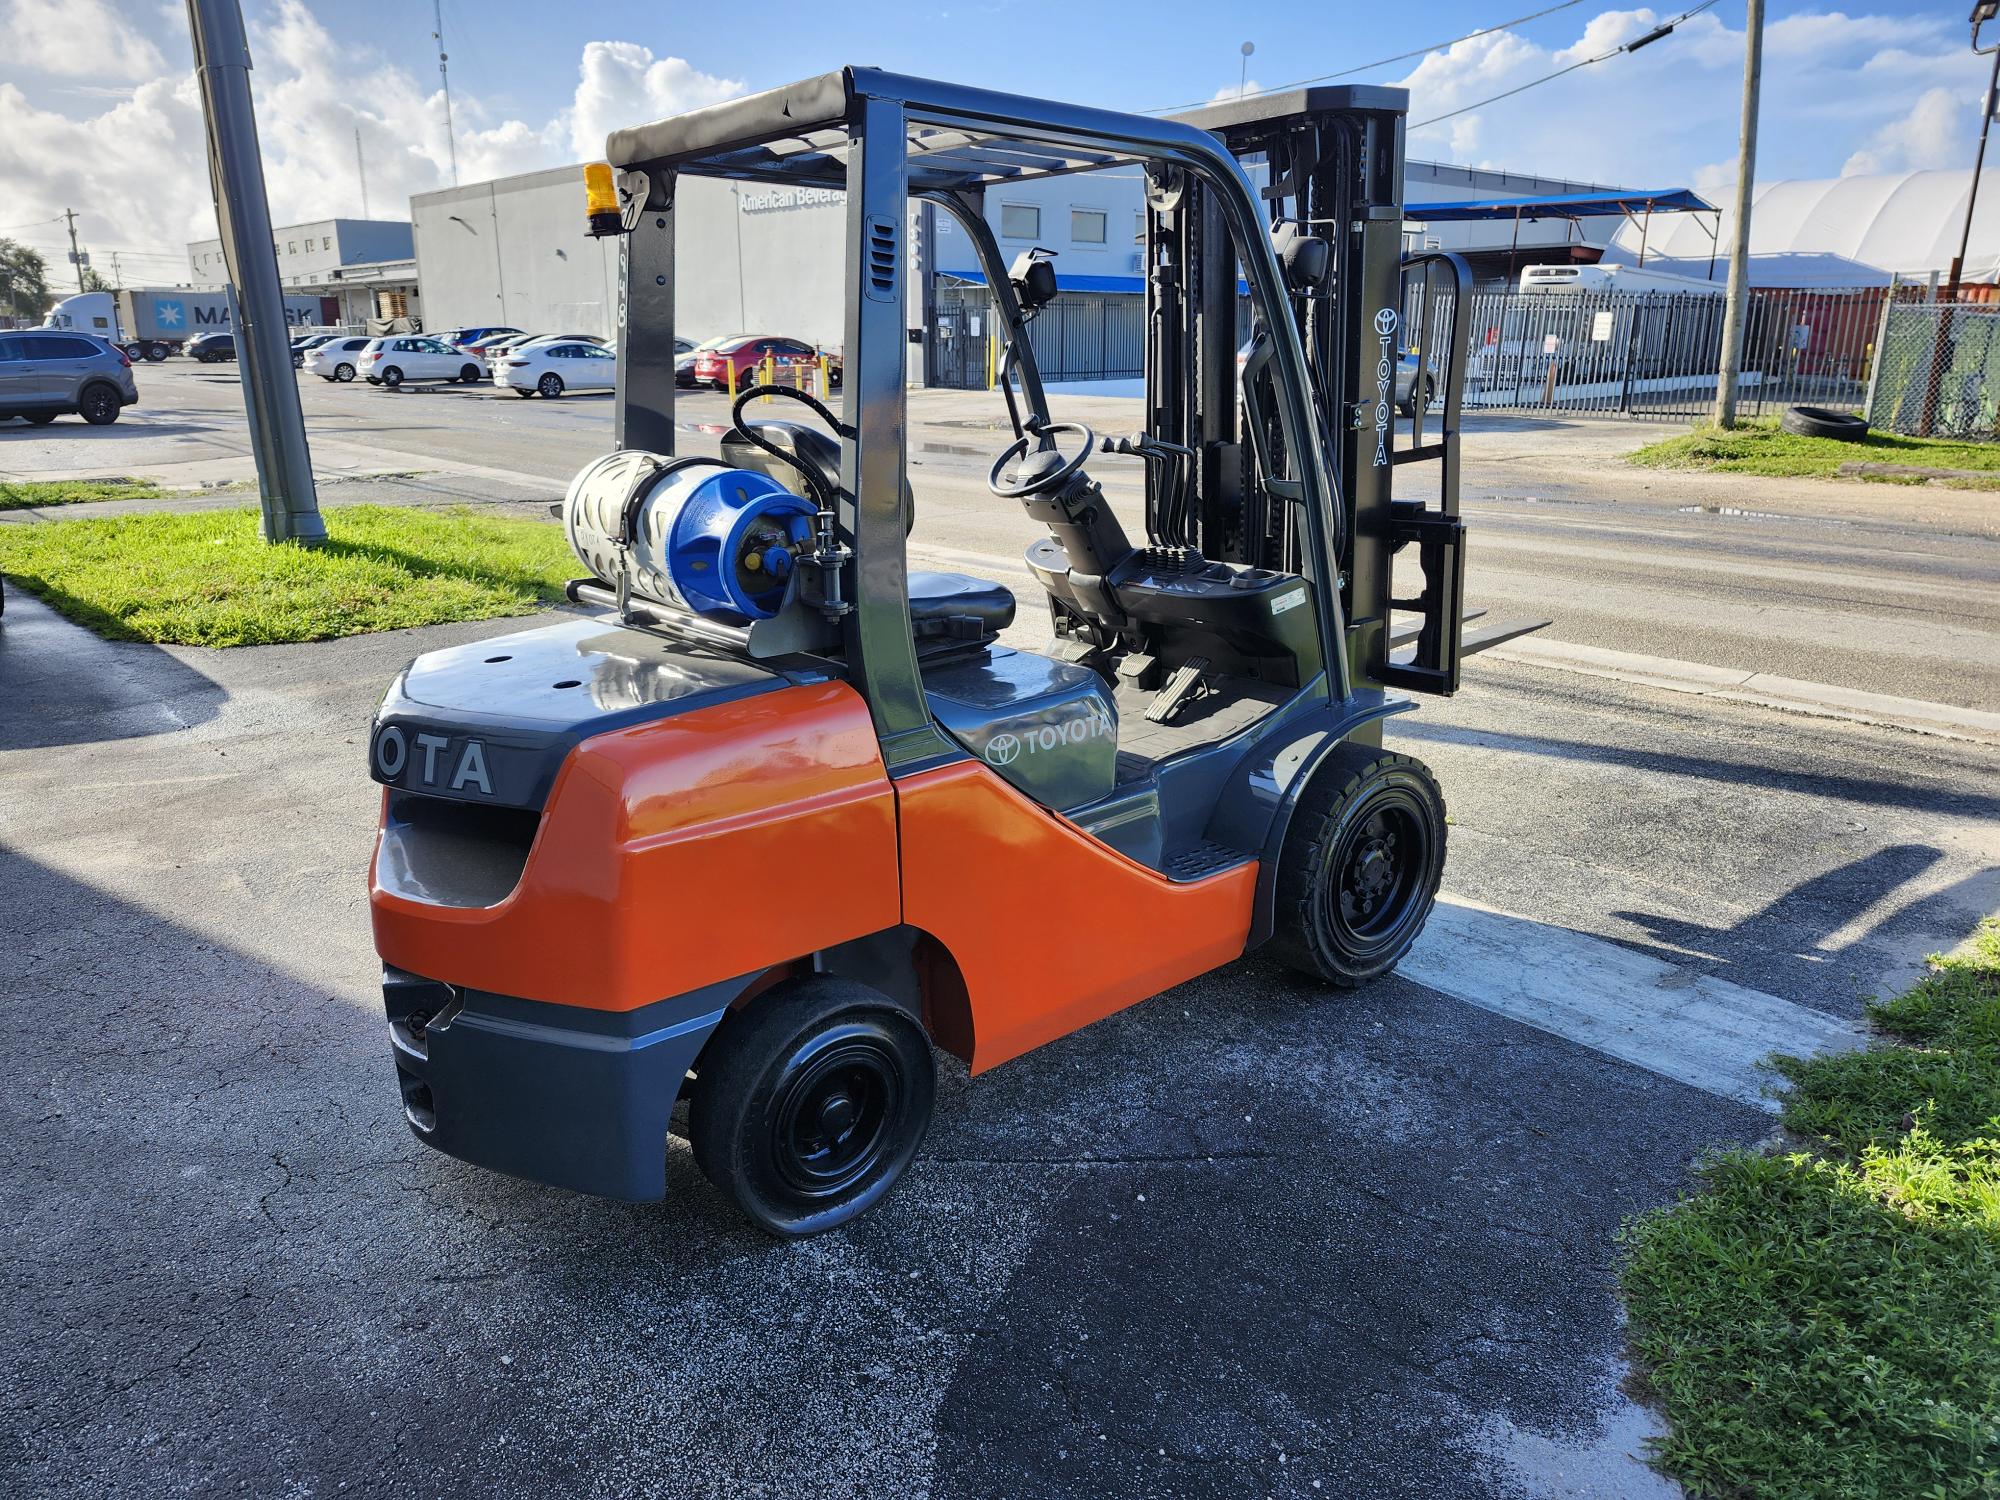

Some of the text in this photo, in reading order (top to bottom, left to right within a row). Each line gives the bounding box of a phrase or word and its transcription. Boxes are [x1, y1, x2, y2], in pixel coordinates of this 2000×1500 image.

[741, 190, 793, 210] American
[910, 213, 919, 270] 7300
[1373, 337, 1391, 466] TOYOTA
[377, 726, 493, 794] OTA
[1024, 711, 1113, 754] TOYOTA
